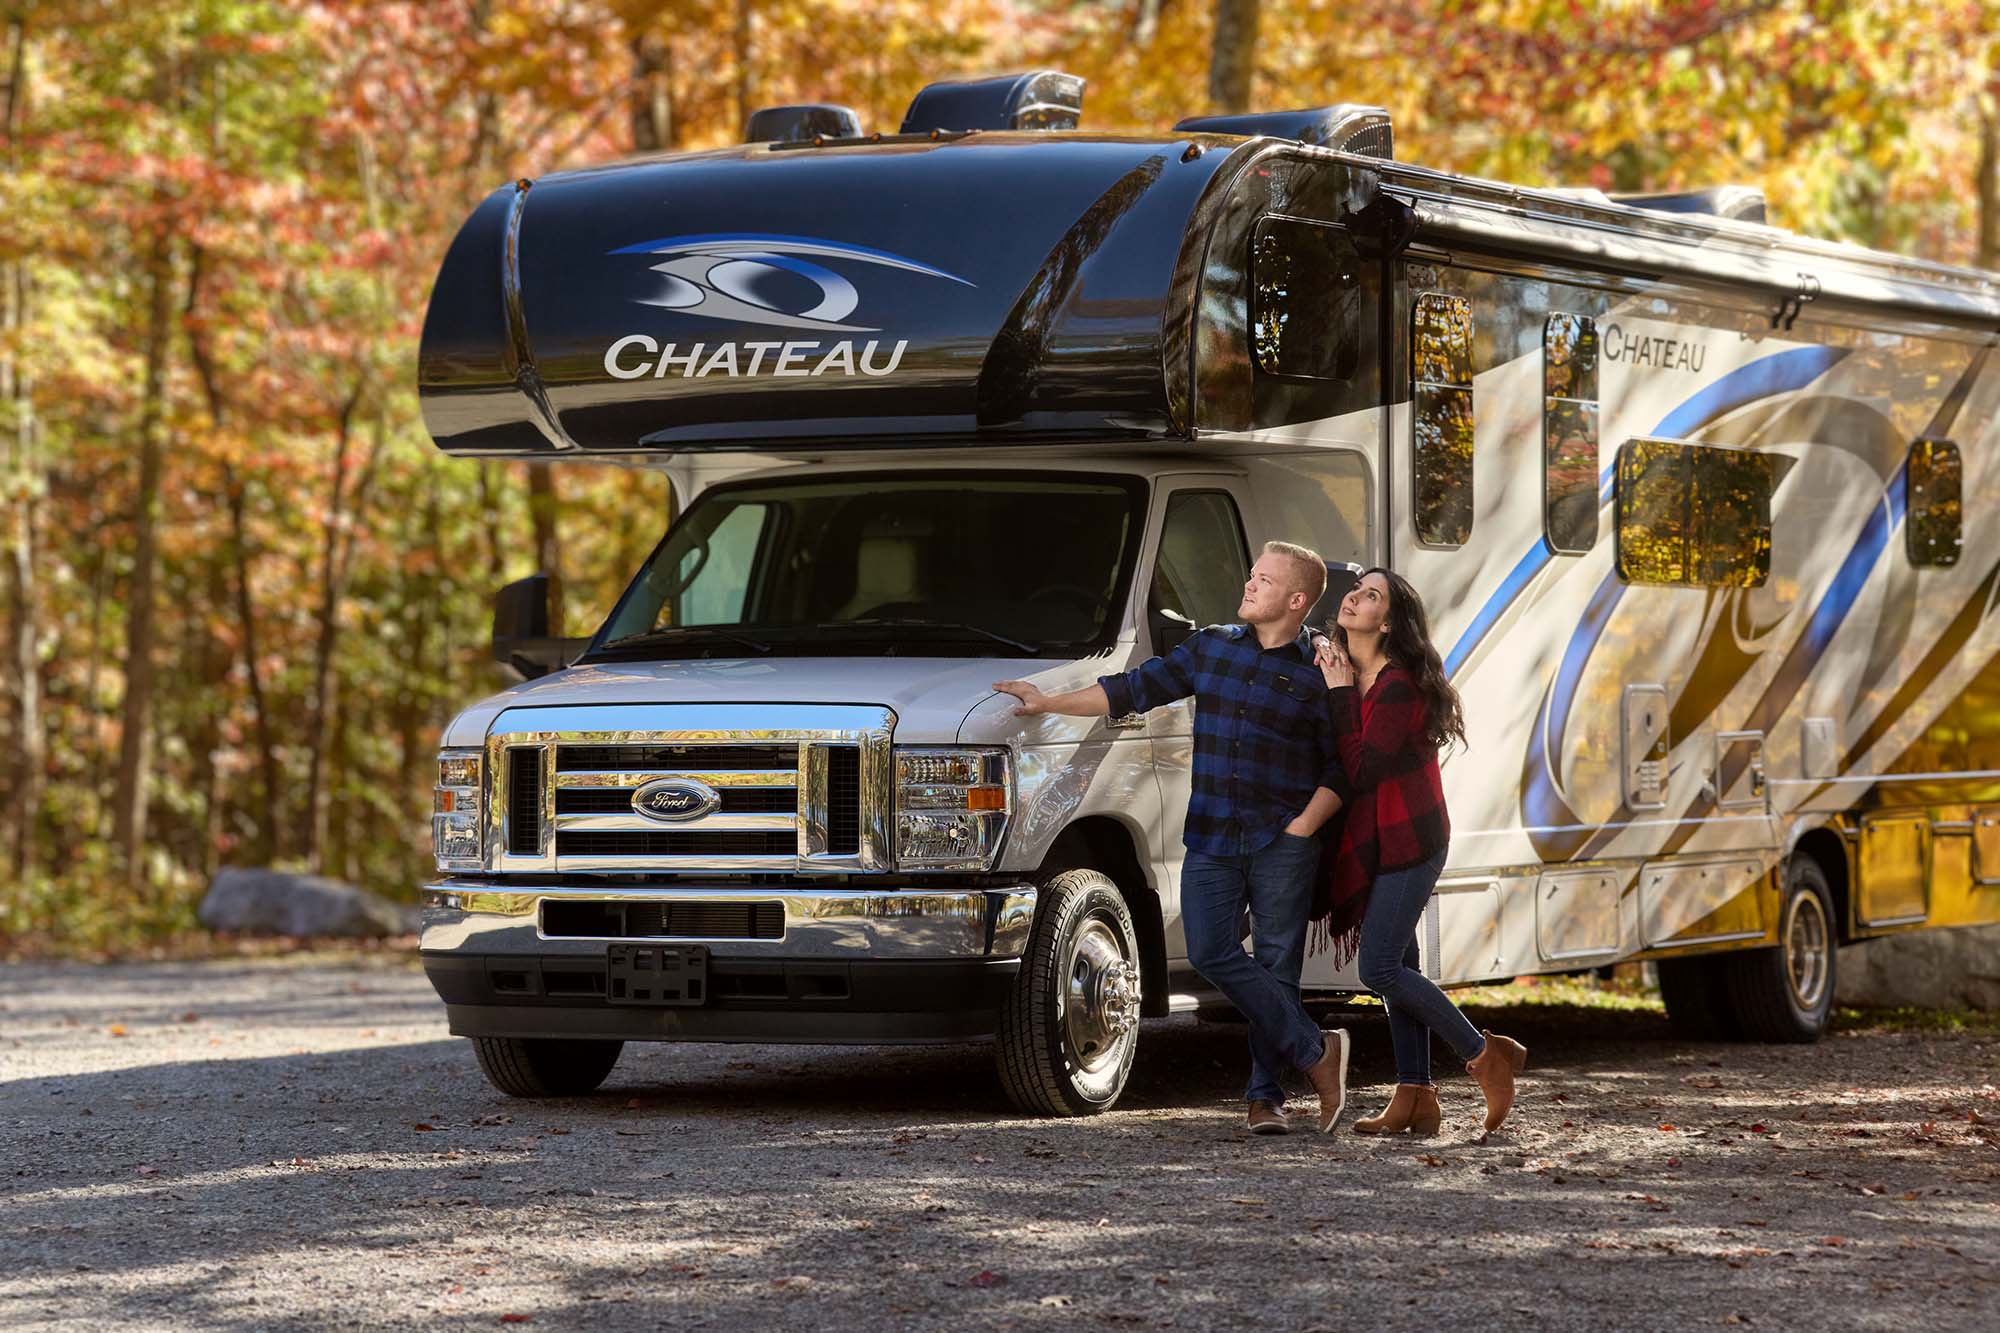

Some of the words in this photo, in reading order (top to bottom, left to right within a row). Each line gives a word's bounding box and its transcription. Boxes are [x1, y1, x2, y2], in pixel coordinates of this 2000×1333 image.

[603, 334, 909, 380] CHATEAU
[1603, 323, 1706, 373] CHATEAU
[651, 791, 690, 809] Ford
